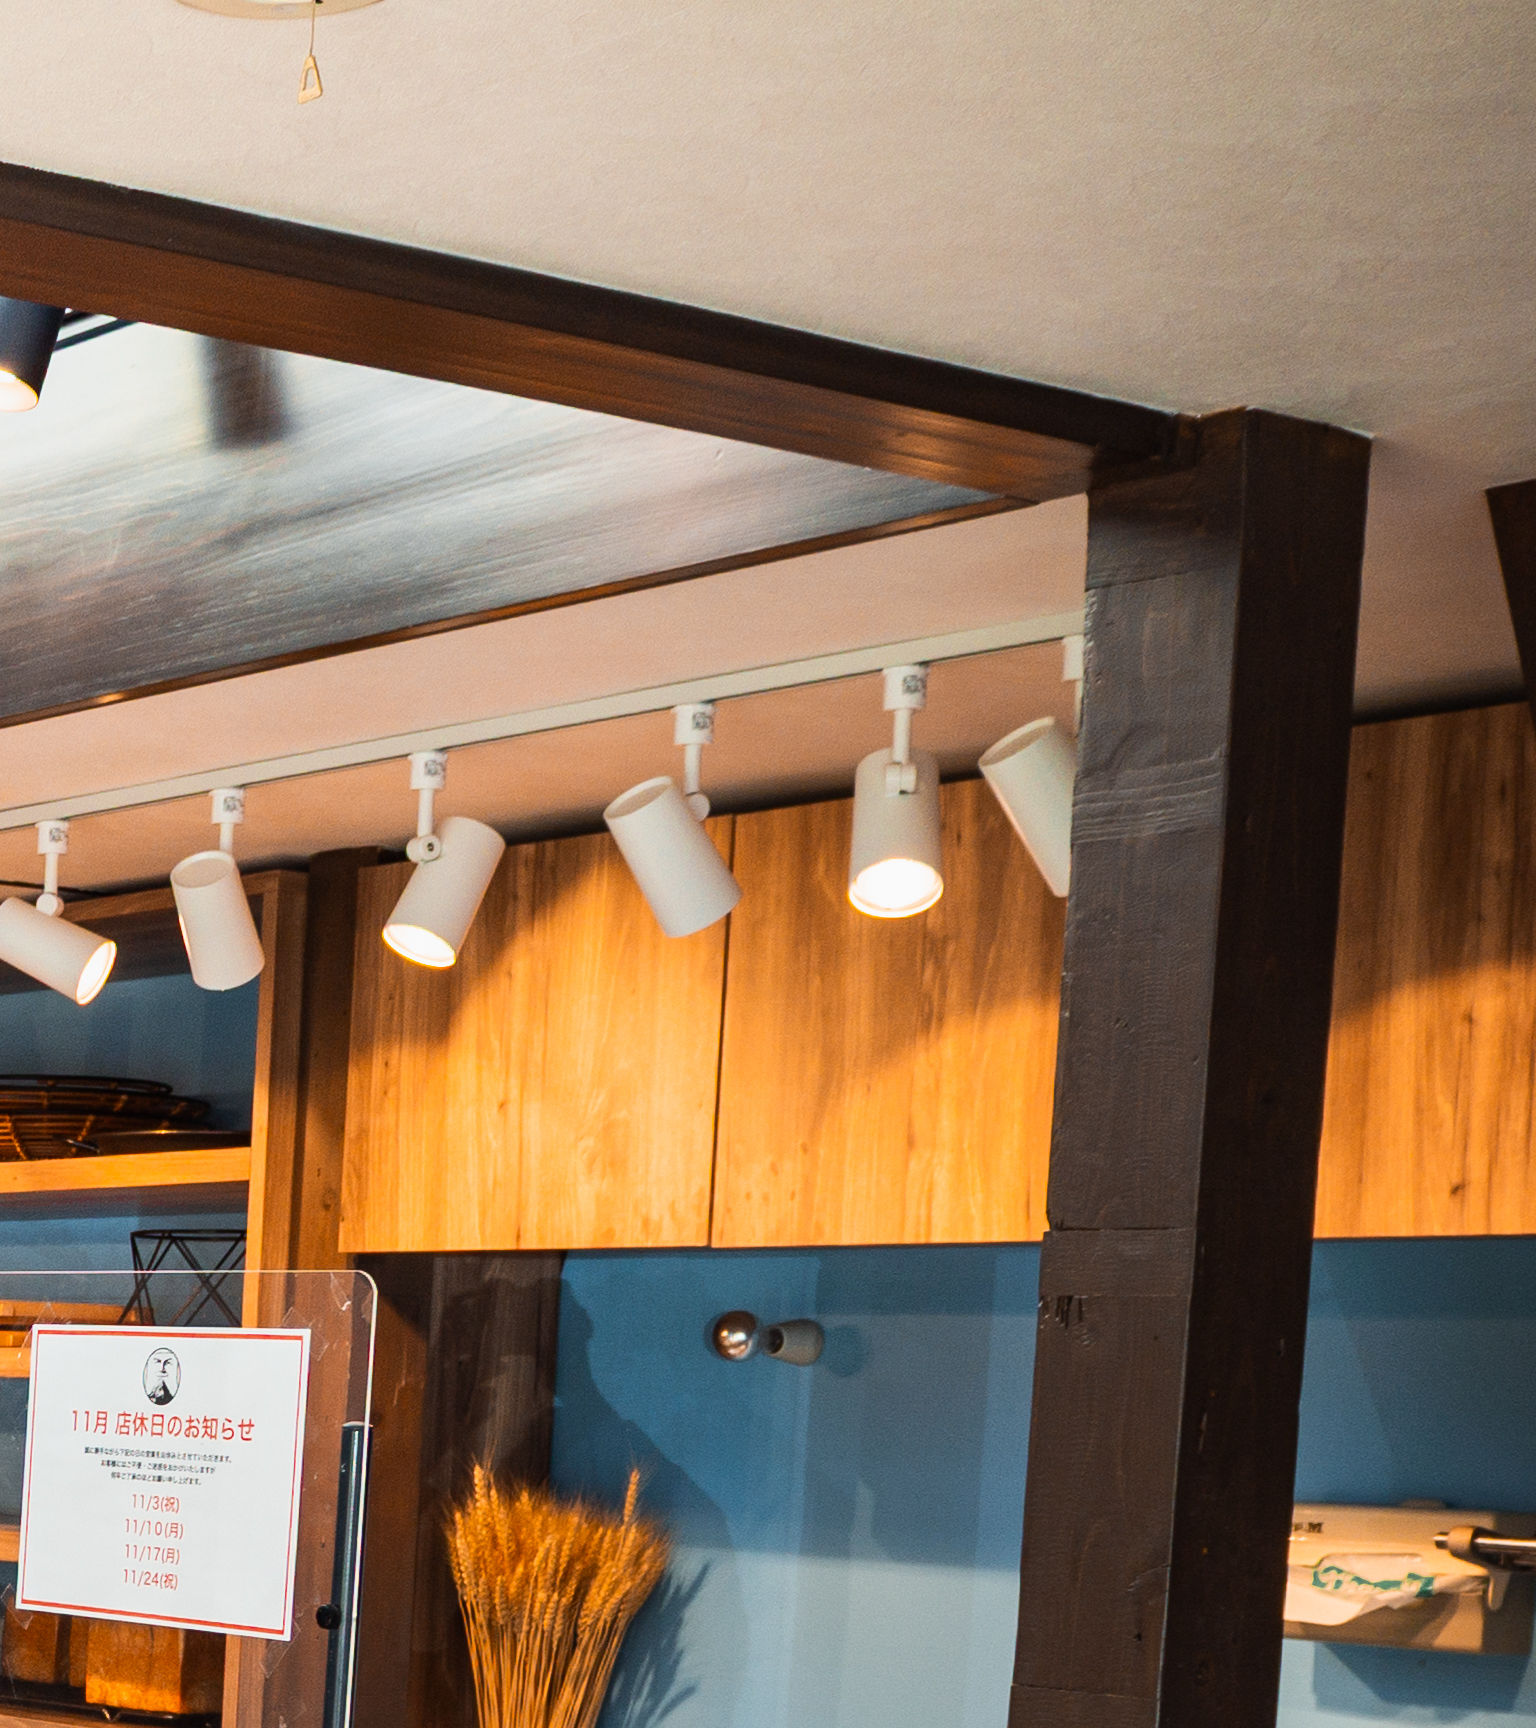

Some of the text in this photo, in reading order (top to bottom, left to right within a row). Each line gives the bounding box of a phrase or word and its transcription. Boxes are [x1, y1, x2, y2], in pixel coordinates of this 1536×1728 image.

[71, 1410, 255, 1441] 11月 店休日のお知らせ
[124, 1518, 185, 1540] 11/10(月)
[124, 1544, 181, 1565] 11/17(月)
[122, 1568, 179, 1591] 11/24(祝)
